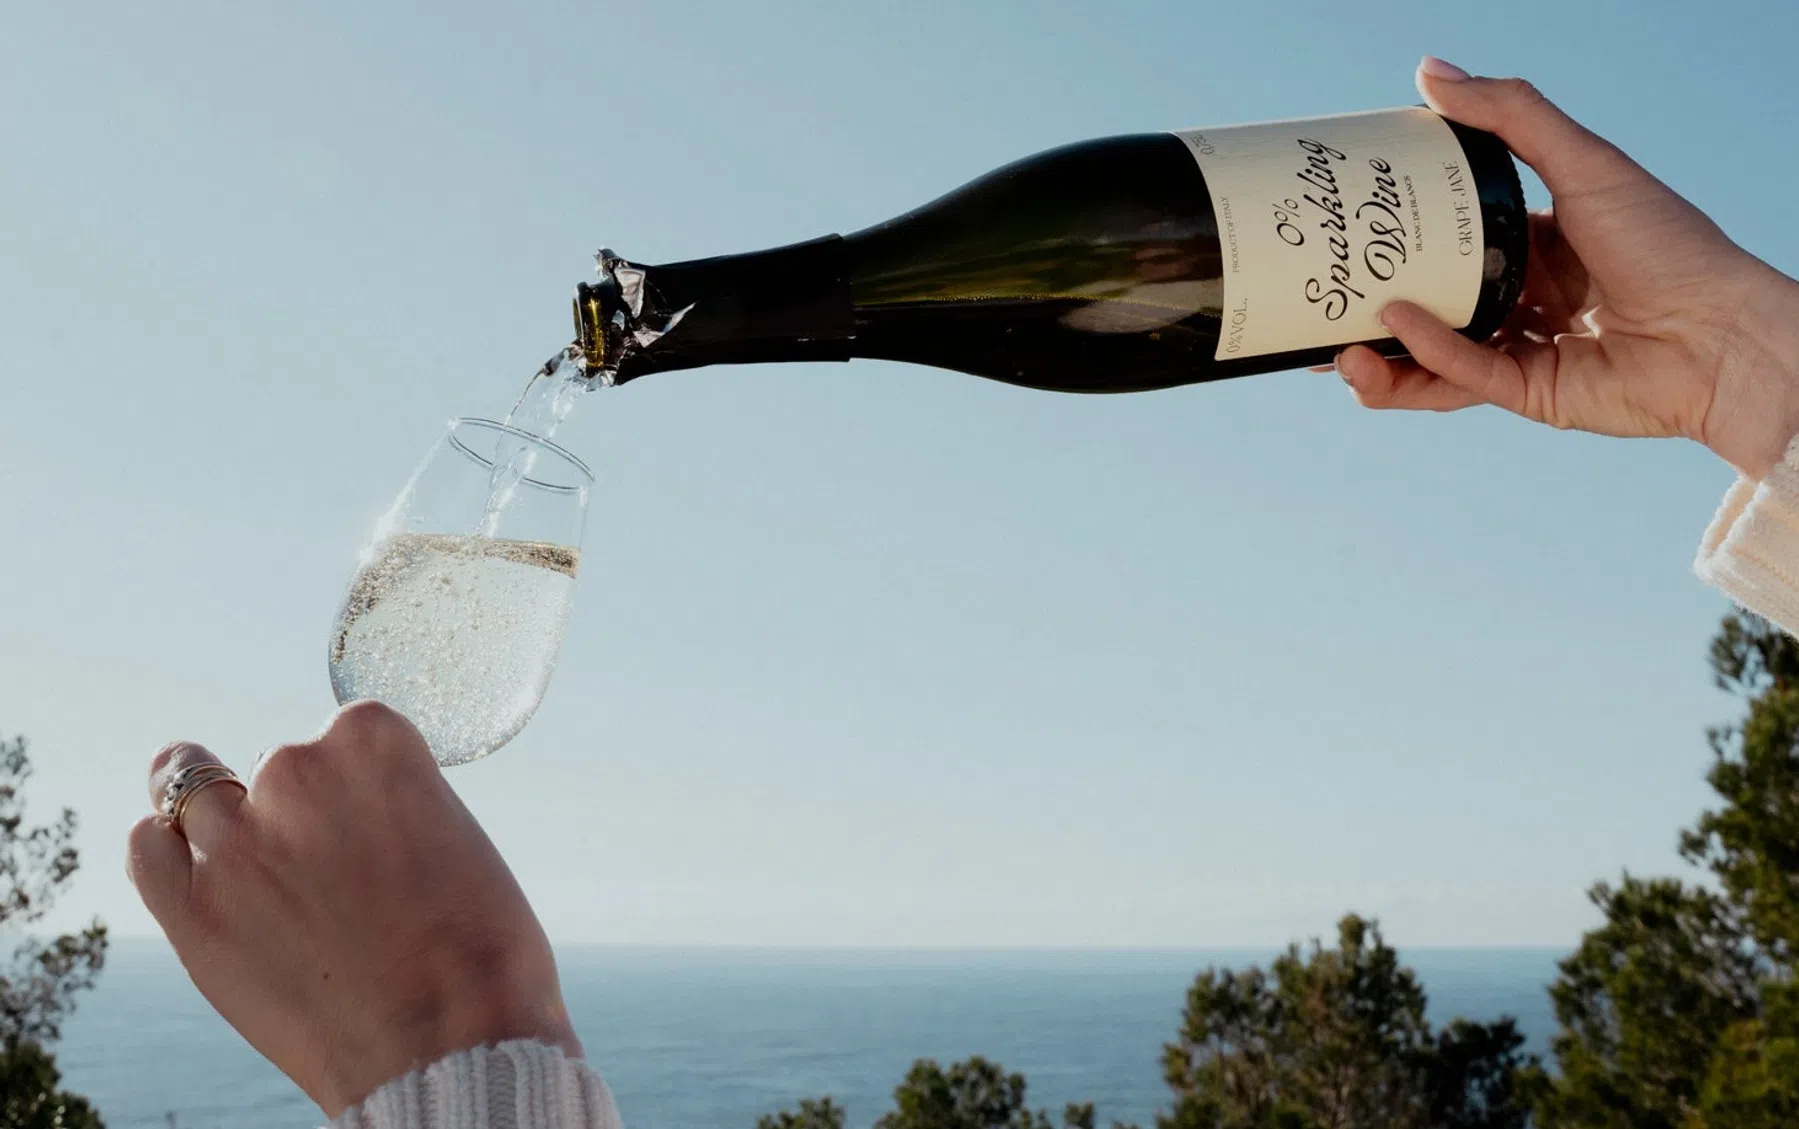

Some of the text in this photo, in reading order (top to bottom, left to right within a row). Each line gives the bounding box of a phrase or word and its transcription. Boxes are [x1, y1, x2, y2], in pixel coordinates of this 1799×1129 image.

[1220, 197, 1239, 273] PRODUCT OF ITALY
[1272, 198, 1305, 246] 0%
[1297, 137, 1365, 321] Sparkling
[1356, 157, 1406, 281] Wine
[1403, 175, 1423, 252] BLANC DE BLANCS
[1442, 161, 1474, 256] GRAPE JANE
